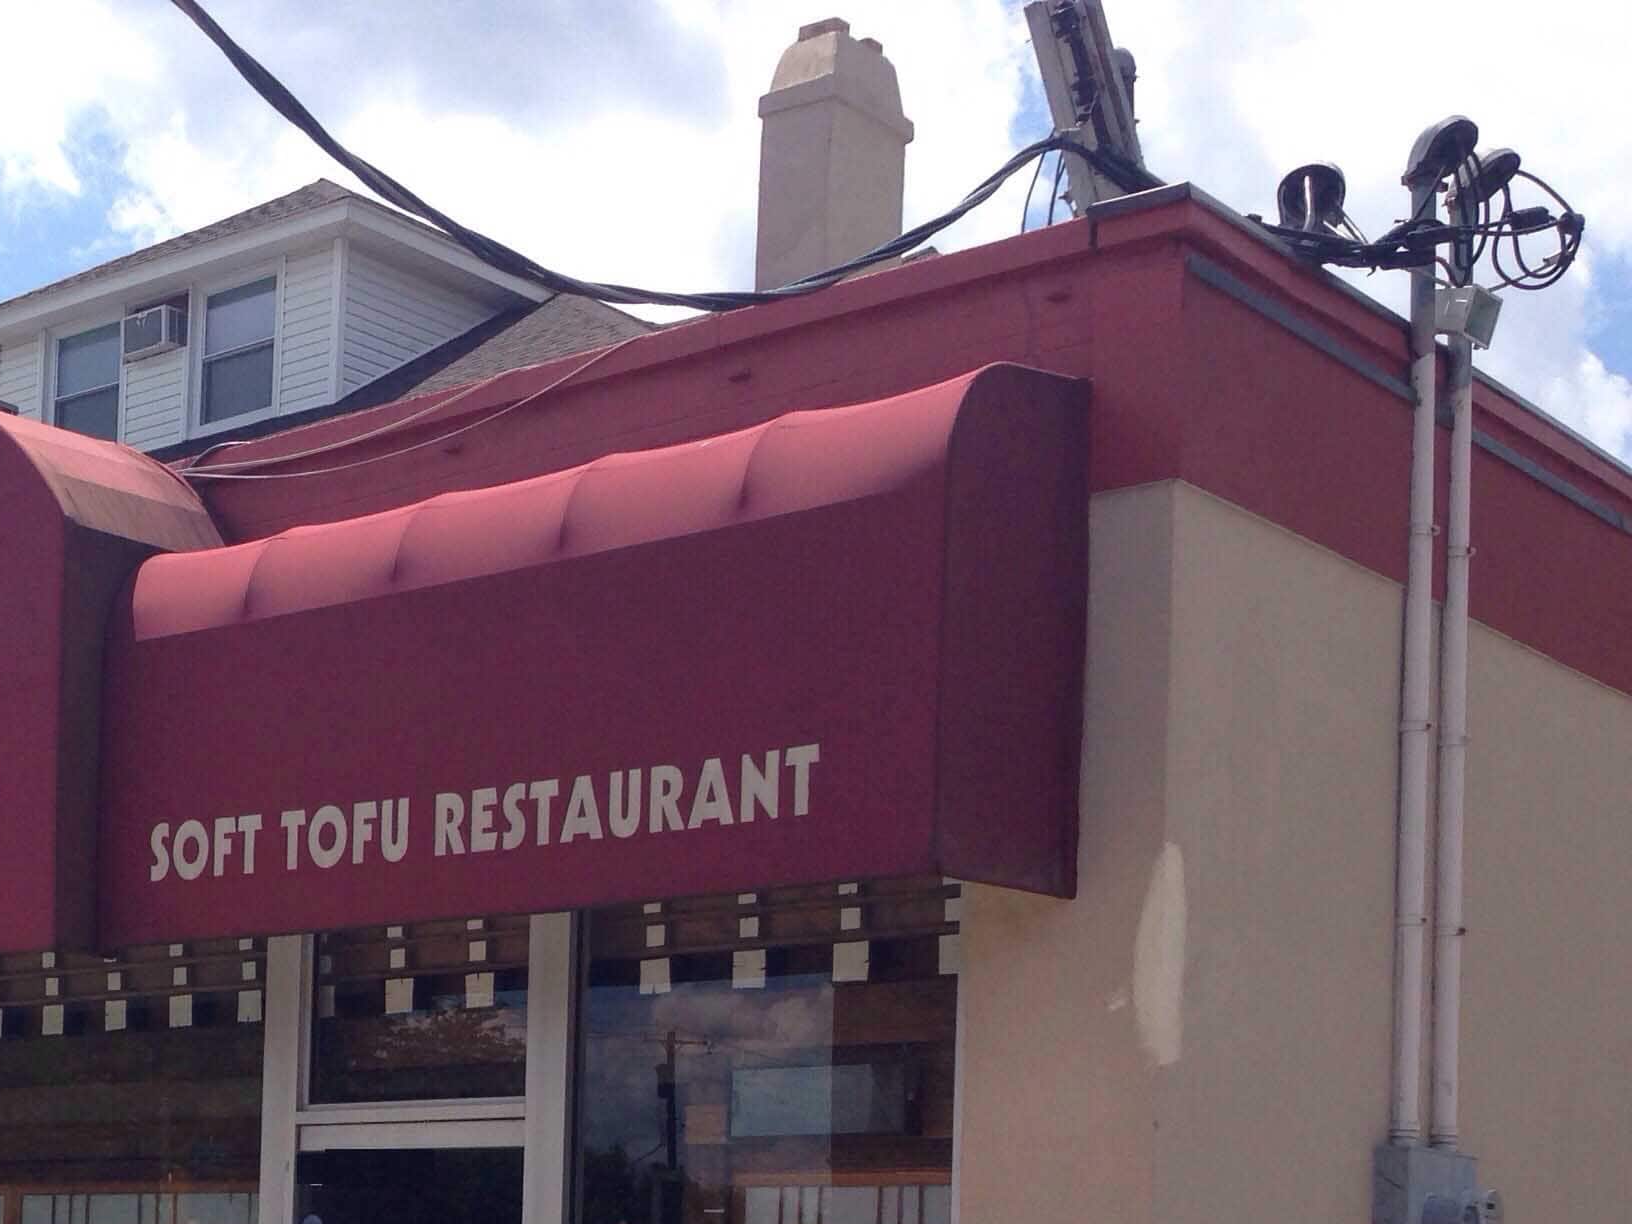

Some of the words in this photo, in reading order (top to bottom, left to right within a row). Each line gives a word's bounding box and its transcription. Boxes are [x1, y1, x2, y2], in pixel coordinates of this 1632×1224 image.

[149, 813, 263, 882] SOFT
[279, 797, 411, 871] TOFU
[433, 743, 820, 858] RESTAURANT
